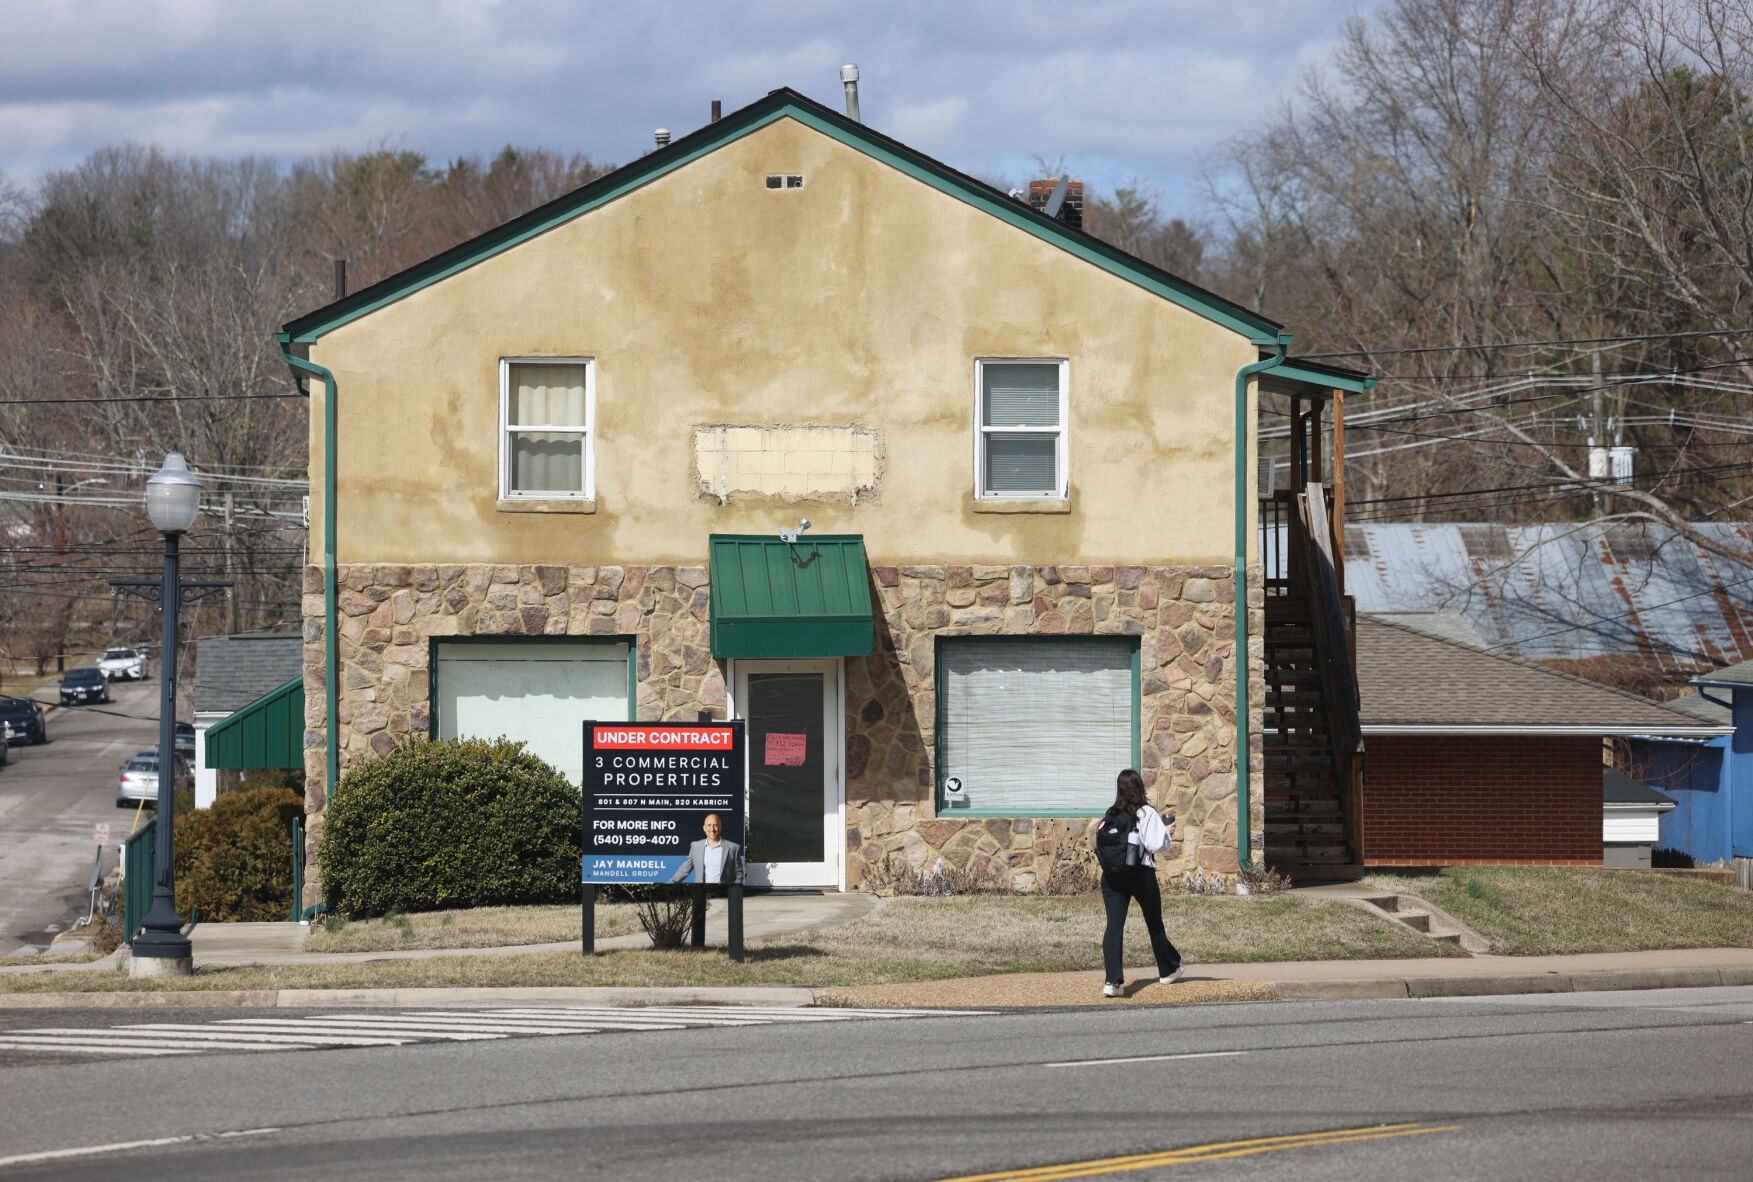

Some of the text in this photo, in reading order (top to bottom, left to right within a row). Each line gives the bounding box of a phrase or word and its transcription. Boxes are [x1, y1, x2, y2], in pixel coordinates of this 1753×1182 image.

[597, 732, 730, 744] UNDER CONTRACT
[595, 757, 730, 769] 3 COMMERCIAL
[604, 773, 721, 786] PROPERTIES
[598, 798, 613, 806] 801
[615, 798, 620, 806] &
[622, 798, 638, 806] 807
[593, 820, 676, 830] FOR MORE INFO
[593, 834, 680, 846] (540) 599-4070
[592, 860, 667, 869] JAY MANDELL
